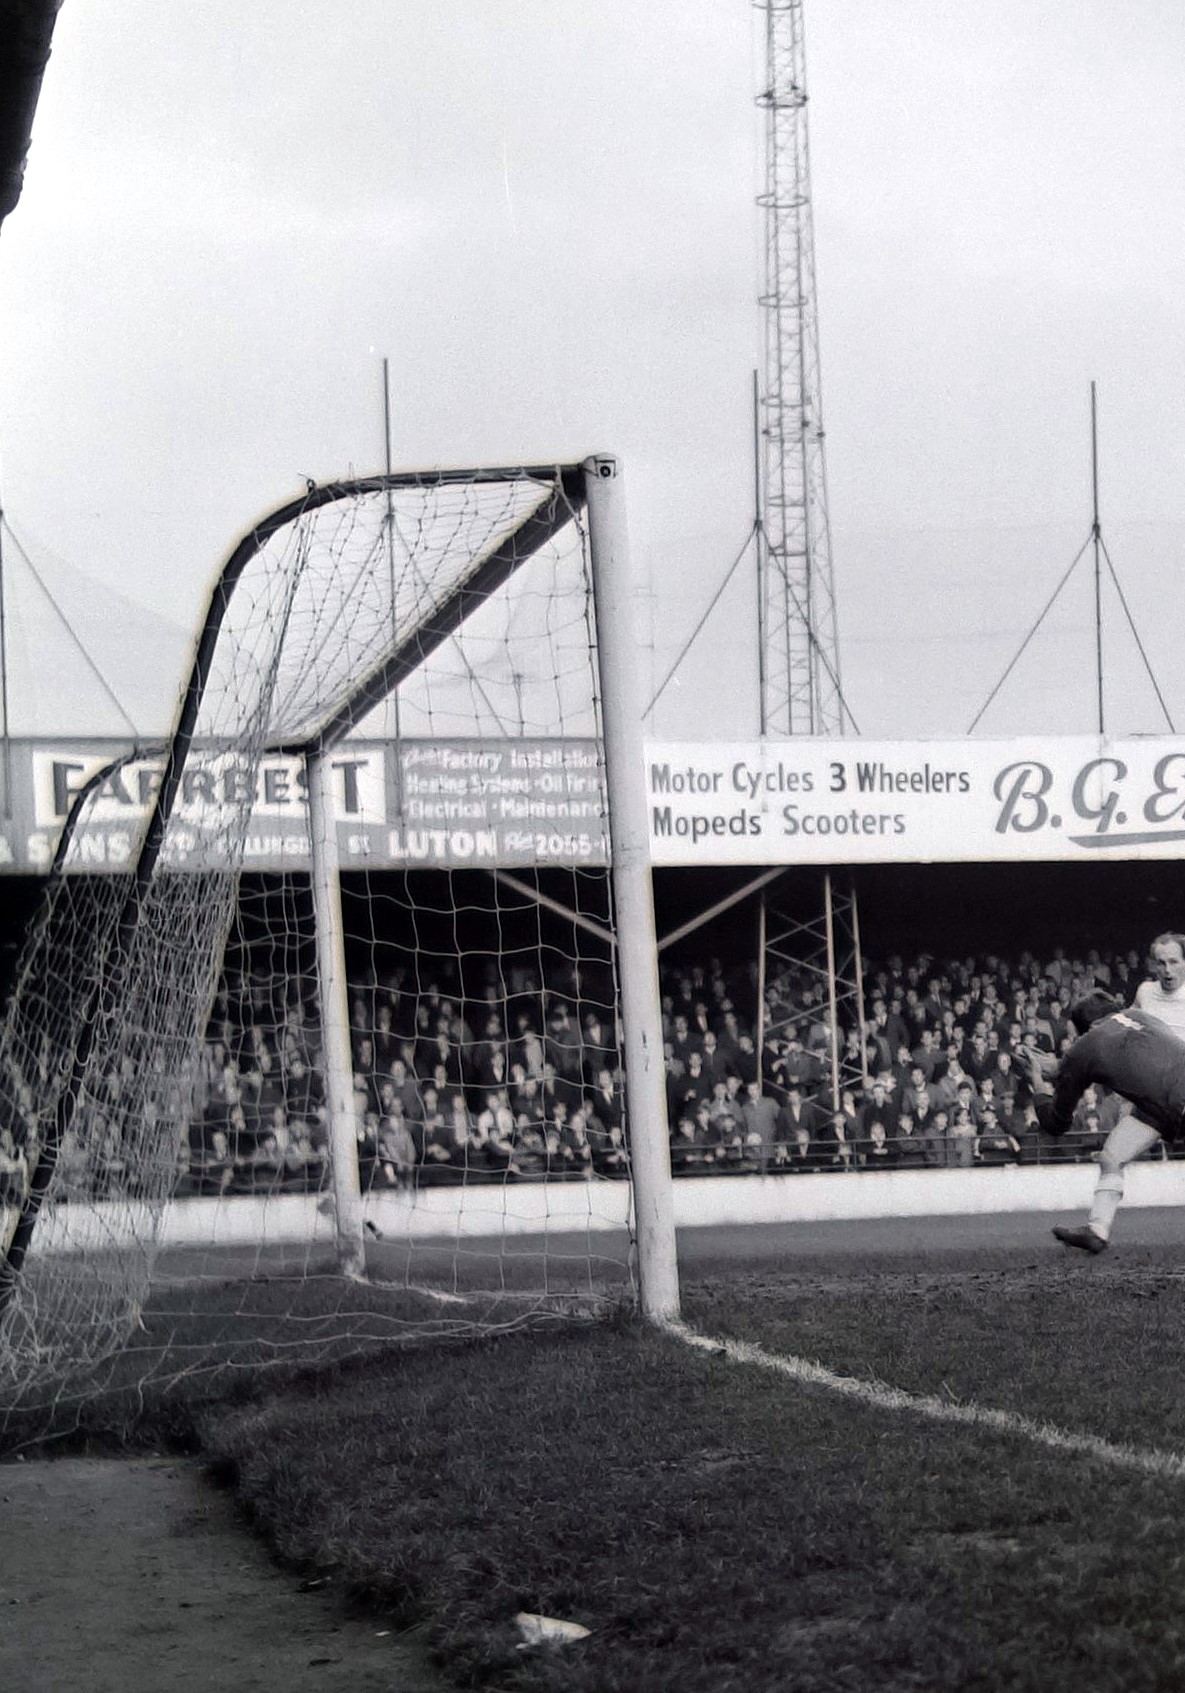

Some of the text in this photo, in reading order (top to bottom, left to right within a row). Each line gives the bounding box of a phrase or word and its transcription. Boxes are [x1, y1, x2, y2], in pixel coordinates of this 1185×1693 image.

[651, 761, 971, 799] Motor Cycles 3 Wheelers
[653, 804, 906, 843] Mopeds Scooters
[390, 830, 498, 859] LUTON
